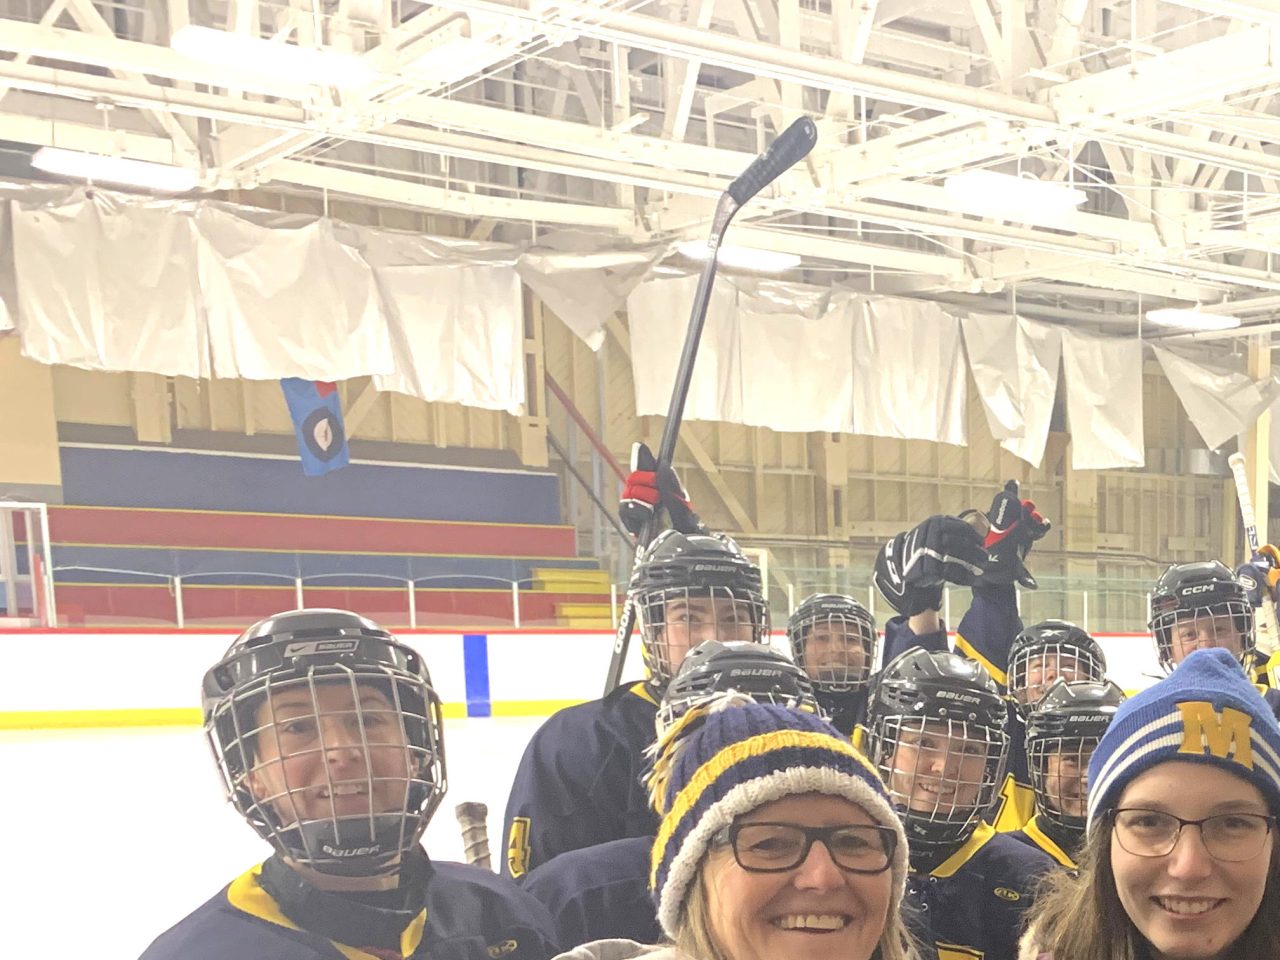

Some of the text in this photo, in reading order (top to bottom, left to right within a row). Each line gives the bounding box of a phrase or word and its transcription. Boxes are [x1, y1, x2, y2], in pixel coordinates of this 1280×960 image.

[695, 563, 737, 573] BAUER
[1181, 583, 1215, 596] CCM
[729, 668, 782, 678] BAUER
[936, 689, 981, 704] BAUER
[1069, 714, 1109, 723] BAUER
[1175, 700, 1254, 772] M
[322, 844, 380, 858] BAUER
